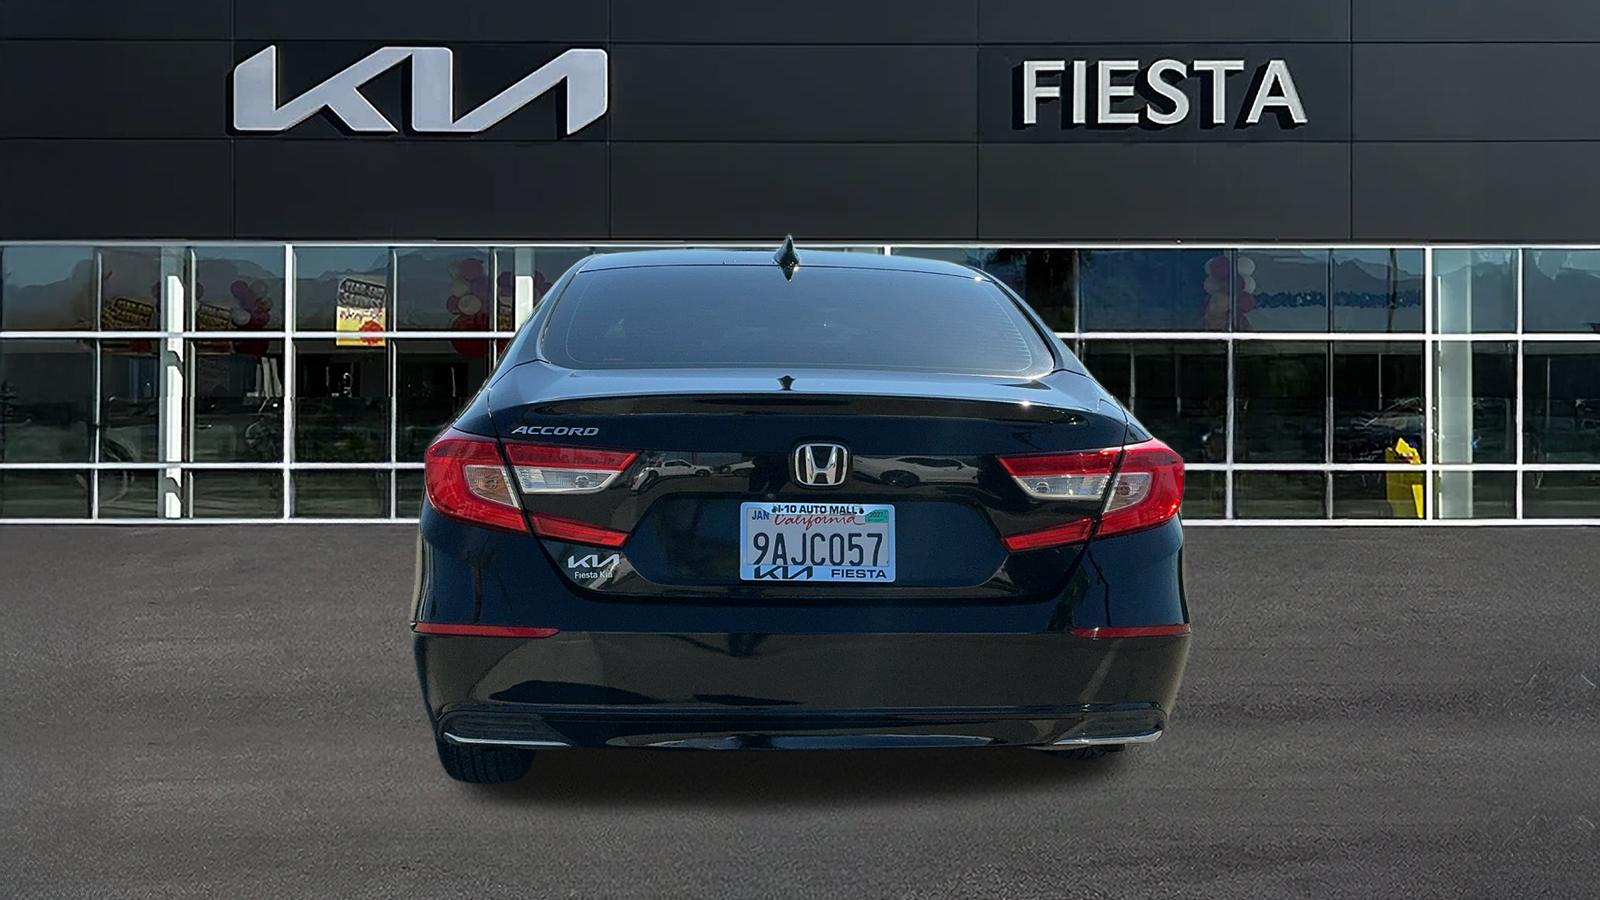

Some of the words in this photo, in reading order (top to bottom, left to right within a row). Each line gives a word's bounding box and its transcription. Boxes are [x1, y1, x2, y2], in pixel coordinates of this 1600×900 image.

[233, 44, 608, 135] KIA
[1023, 59, 1308, 125] FIESTA
[511, 425, 600, 436] ACCORD
[751, 510, 770, 520] JAN
[799, 505, 828, 514] AUTO
[829, 505, 858, 515] MALL
[774, 514, 866, 531] California
[753, 532, 883, 567] 9AJC057
[567, 553, 620, 569] KIA
[574, 571, 598, 580] Fiesta
[599, 571, 613, 579] Kia
[831, 569, 887, 579] FIESTA
